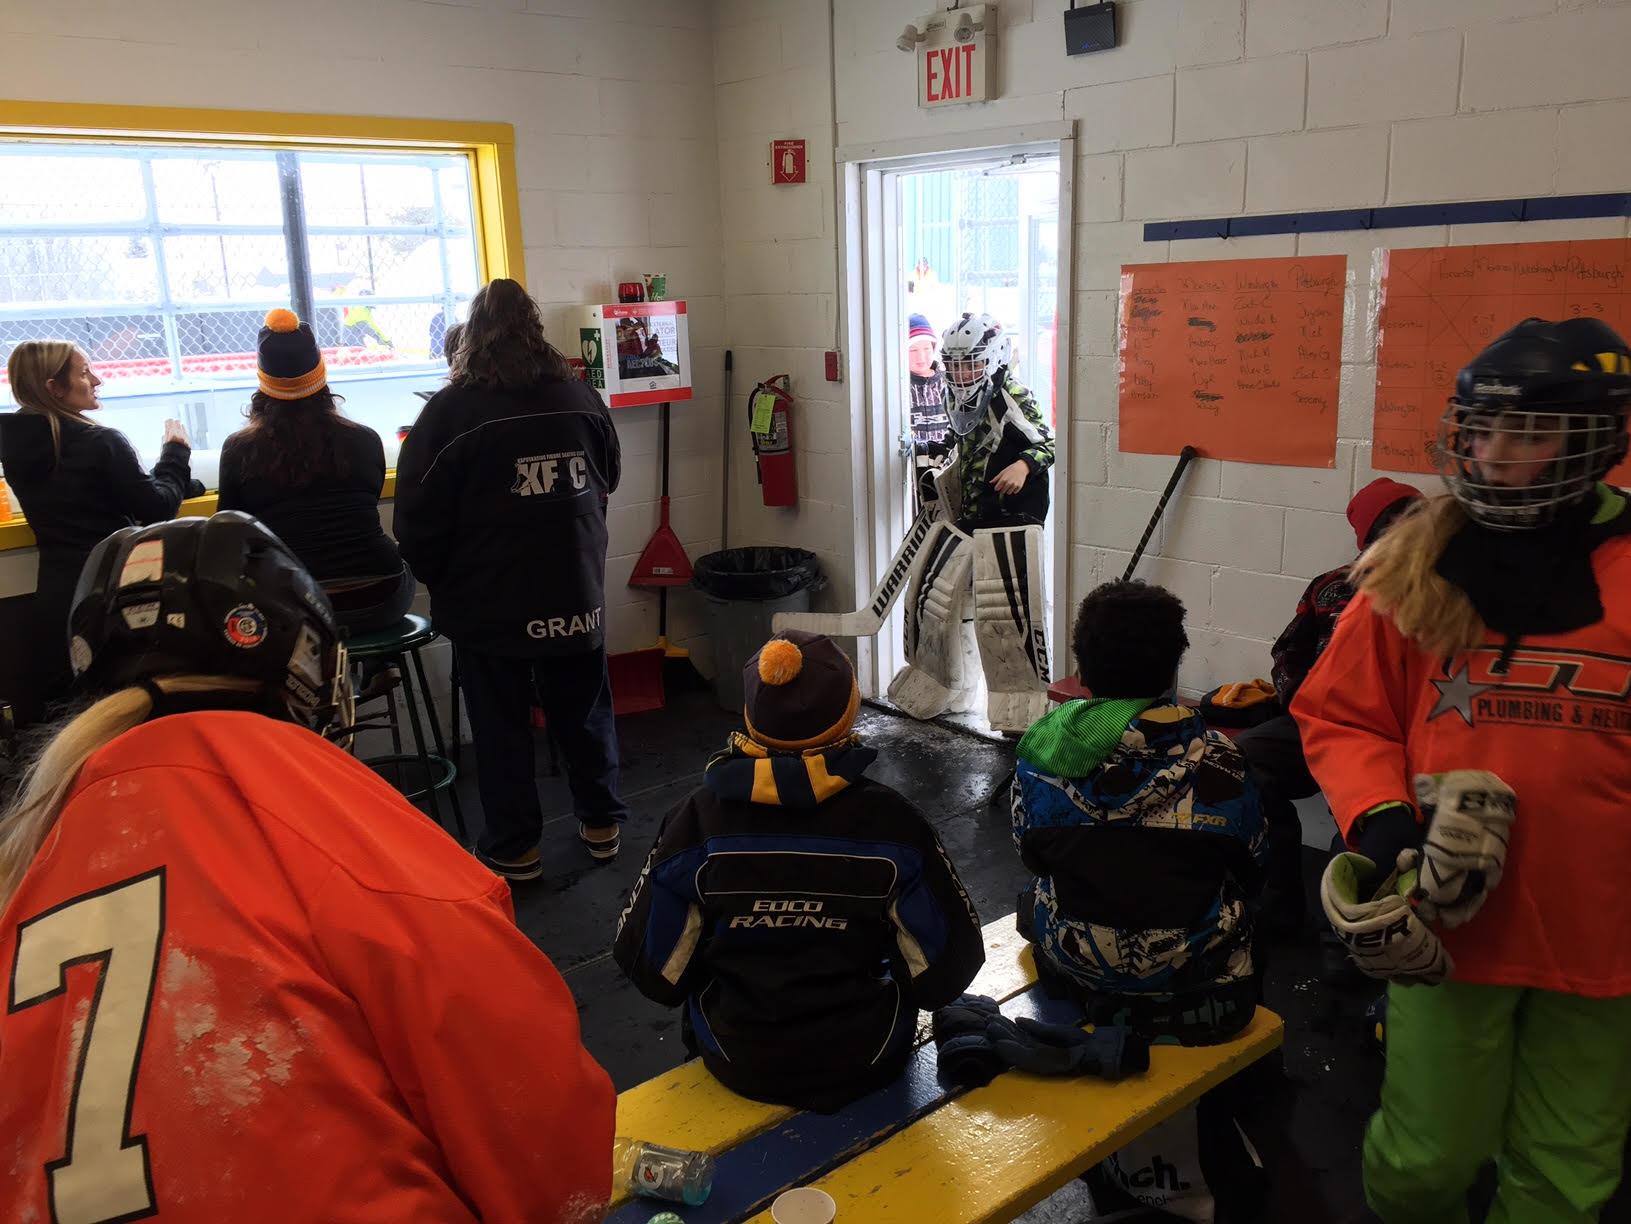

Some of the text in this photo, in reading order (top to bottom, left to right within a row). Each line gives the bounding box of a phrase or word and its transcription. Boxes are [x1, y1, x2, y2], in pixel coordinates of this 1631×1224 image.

[926, 43, 976, 101] EXIT
[527, 607, 601, 639] GRANT
[1034, 628, 1051, 684] CCM
[1477, 698, 1563, 722] PLUMBING
[1572, 703, 1583, 724] &
[728, 915, 849, 931] RACING
[7, 865, 166, 1224] 7
